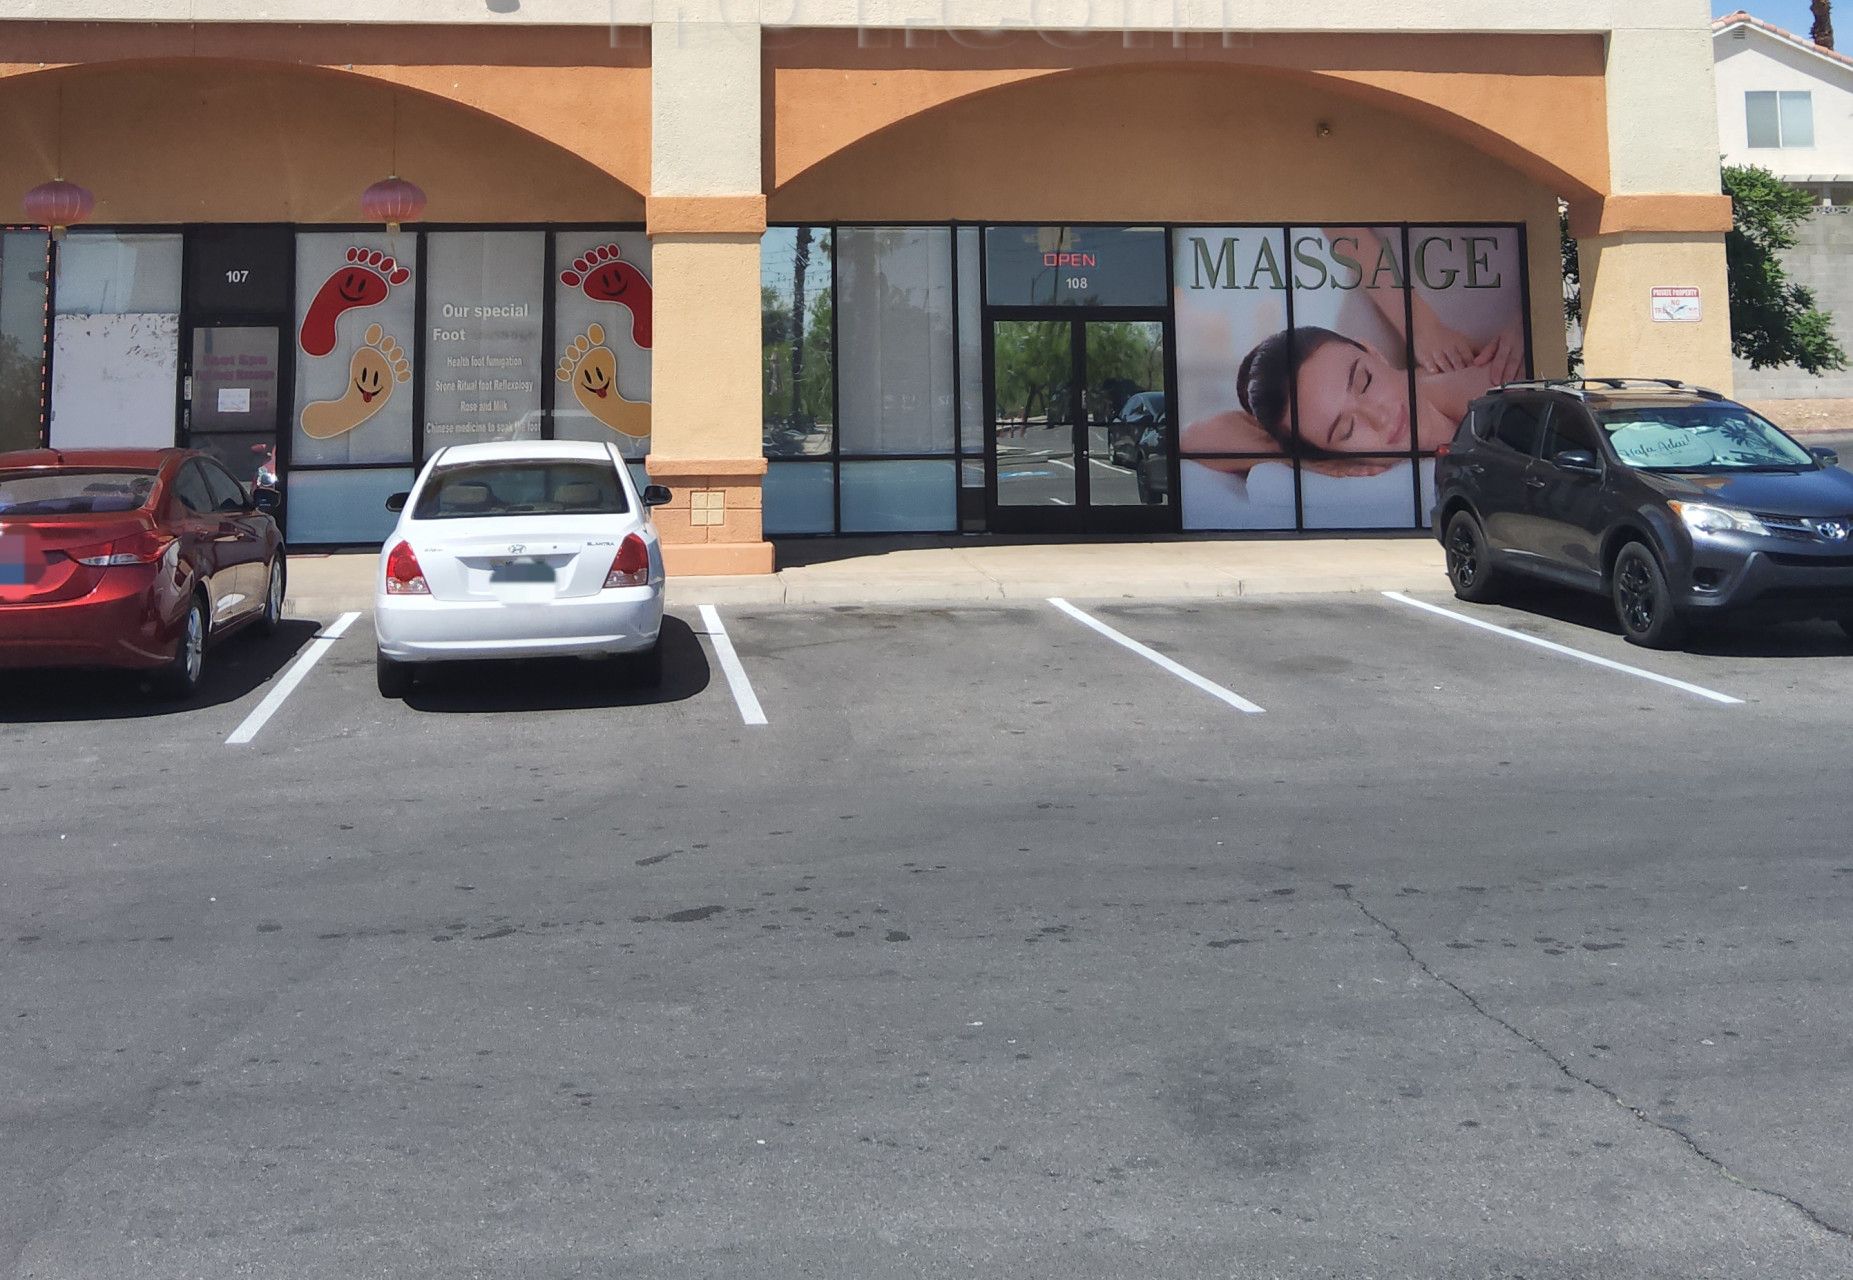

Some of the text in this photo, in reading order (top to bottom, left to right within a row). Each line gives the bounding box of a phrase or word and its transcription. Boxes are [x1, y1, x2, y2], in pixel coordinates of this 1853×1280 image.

[1044, 253, 1095, 267] OPEN
[1188, 236, 1502, 291] MASSAGE
[225, 270, 249, 283] 107
[1065, 277, 1088, 289] 108
[442, 303, 529, 320] Our special
[432, 328, 466, 341] Foot
[447, 356, 470, 367] Health
[471, 355, 485, 367] foot
[478, 400, 492, 411] and
[487, 421, 496, 432] to
